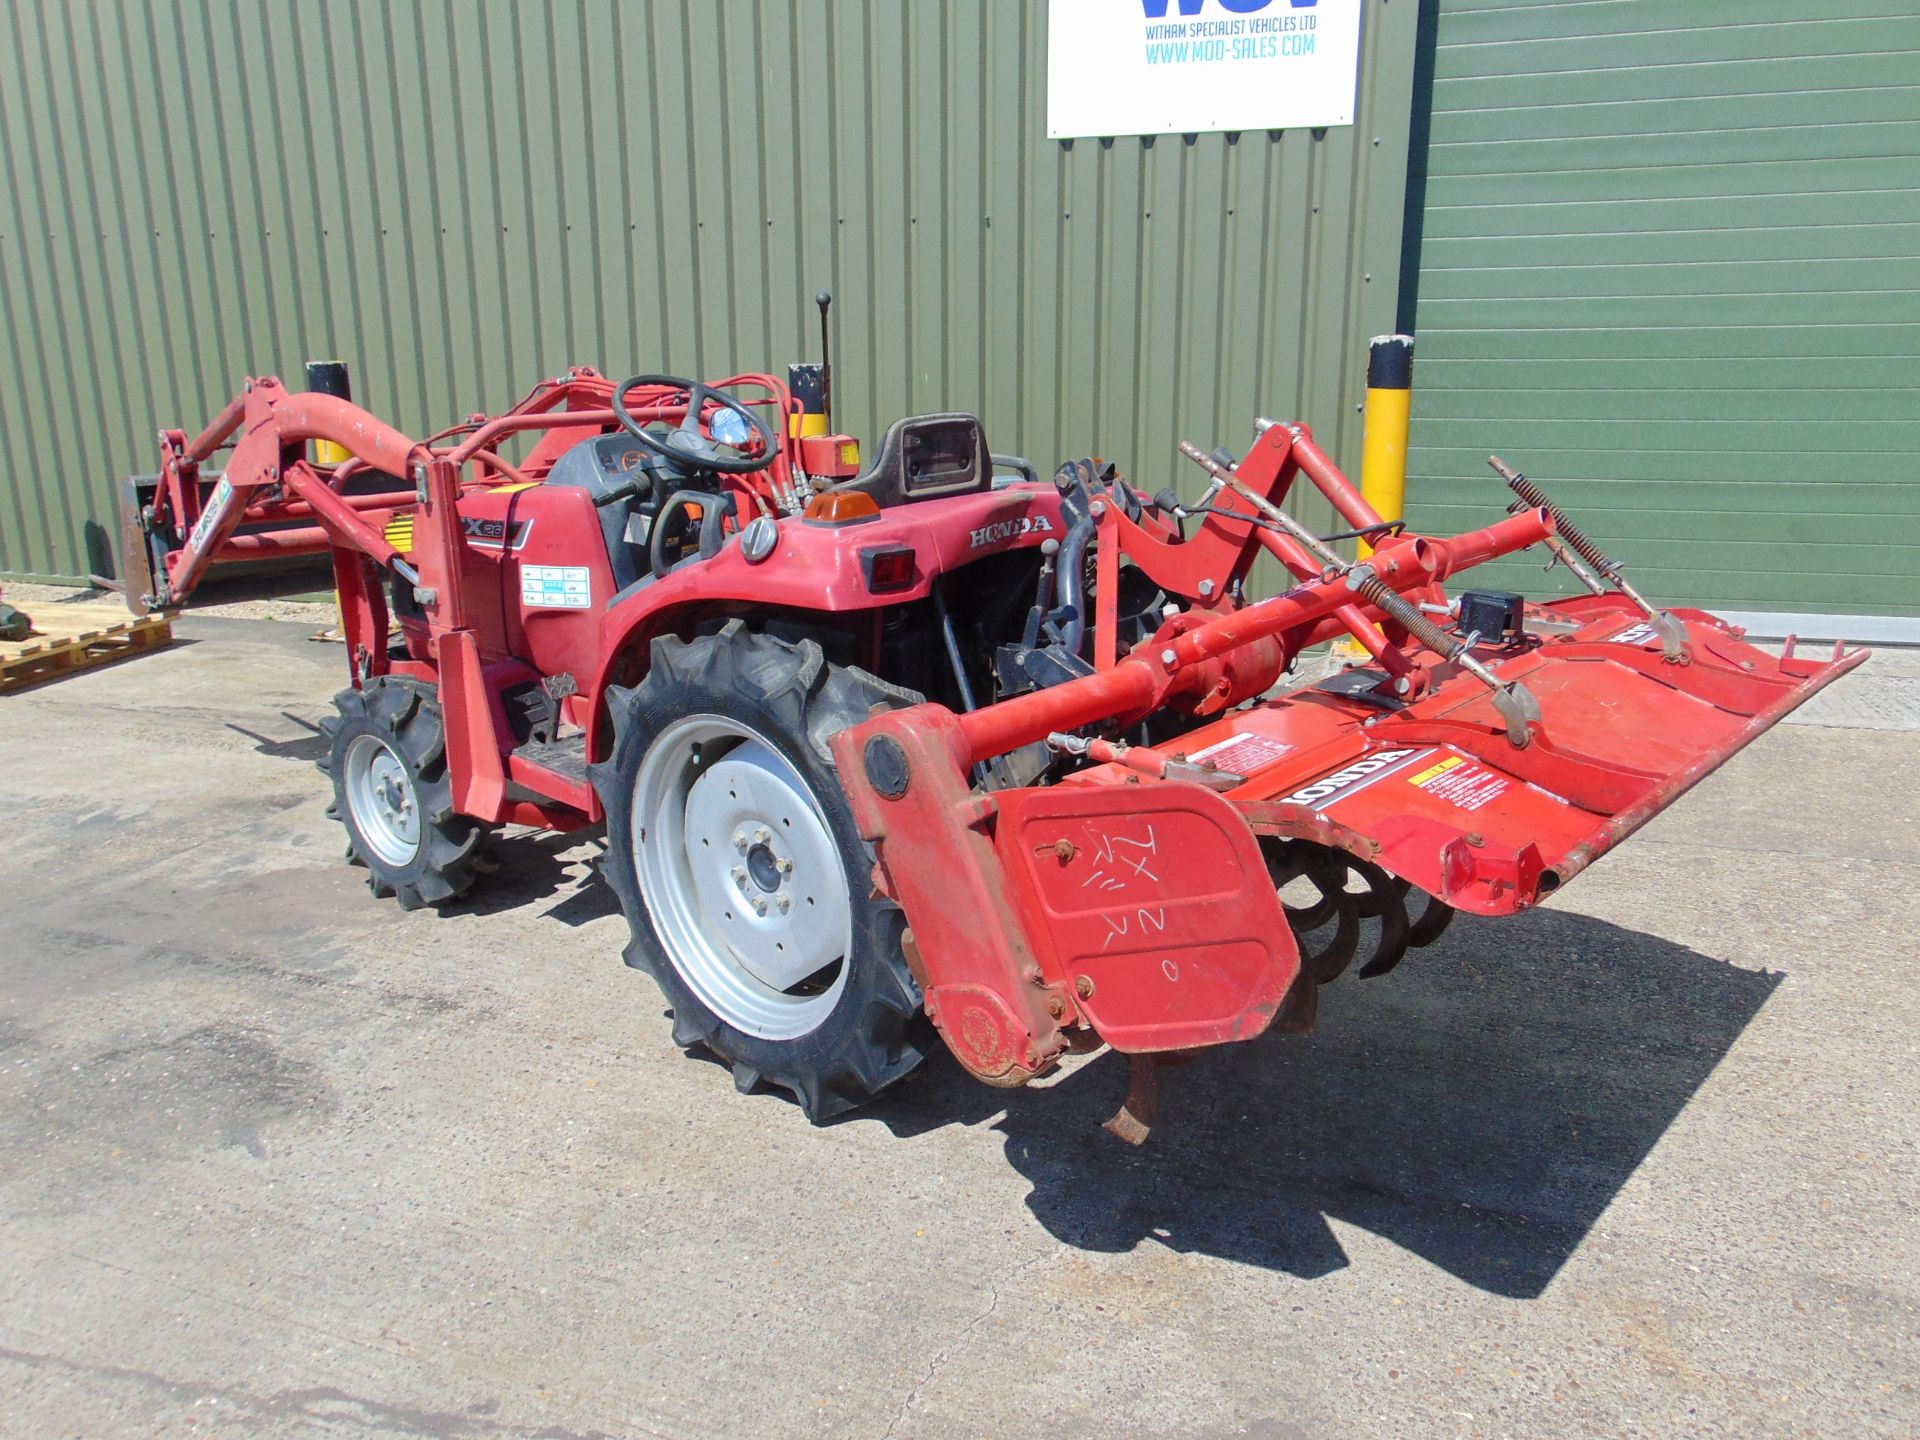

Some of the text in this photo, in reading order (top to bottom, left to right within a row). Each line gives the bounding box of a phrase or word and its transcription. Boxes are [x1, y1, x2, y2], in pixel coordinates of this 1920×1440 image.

[1145, 14, 1317, 40] WITHAM SPECIALIST VEHICLES LTD
[1145, 33, 1316, 65] WWWMOD-SALESCOM
[970, 515, 1053, 548] HONDA
